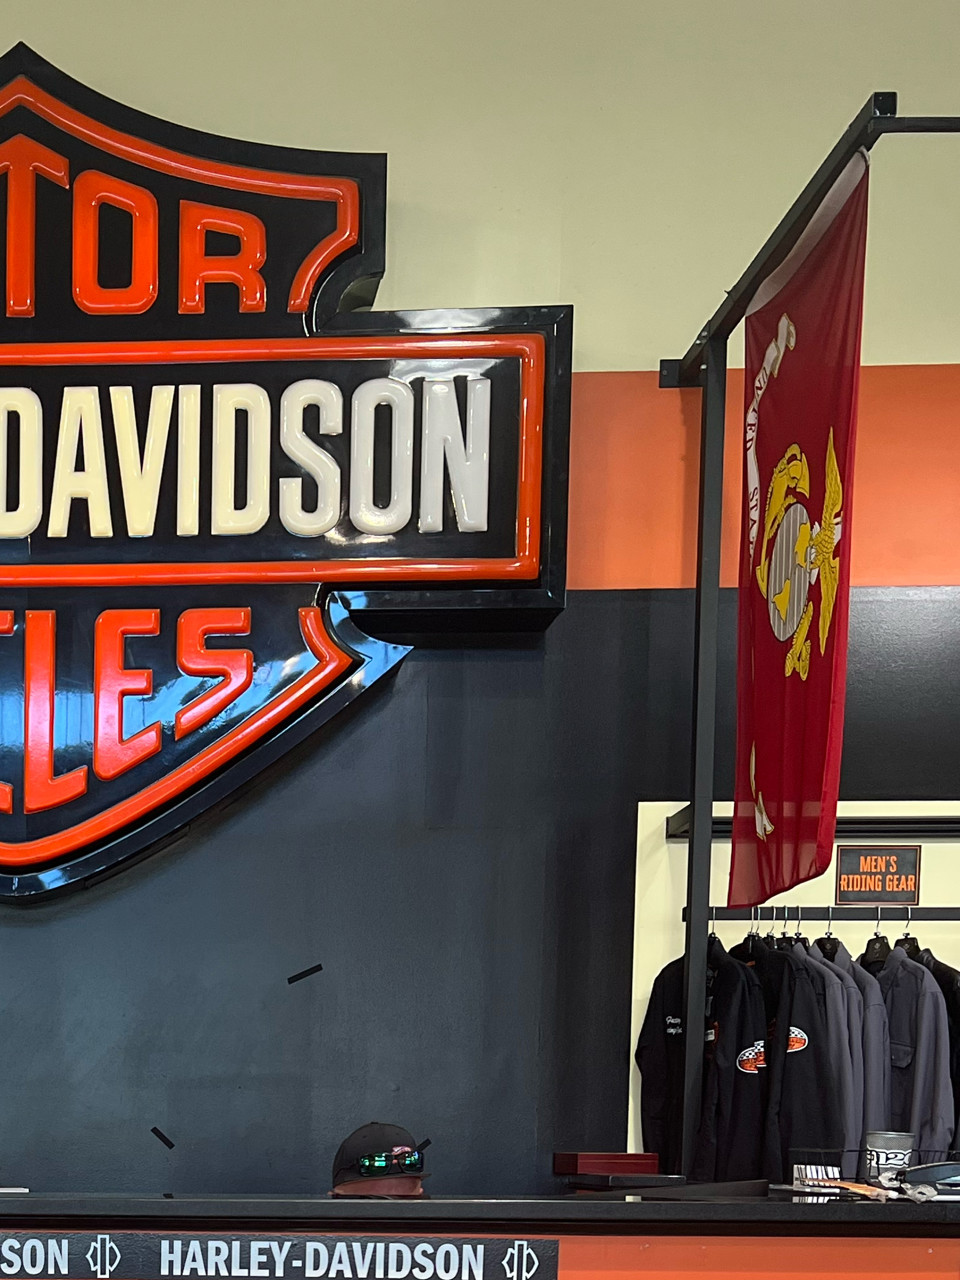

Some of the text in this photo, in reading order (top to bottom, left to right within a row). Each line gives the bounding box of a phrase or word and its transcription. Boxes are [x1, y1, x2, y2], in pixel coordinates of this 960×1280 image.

[860, 855, 897, 872] MEN'S
[840, 875, 915, 891] RIDING GEAR
